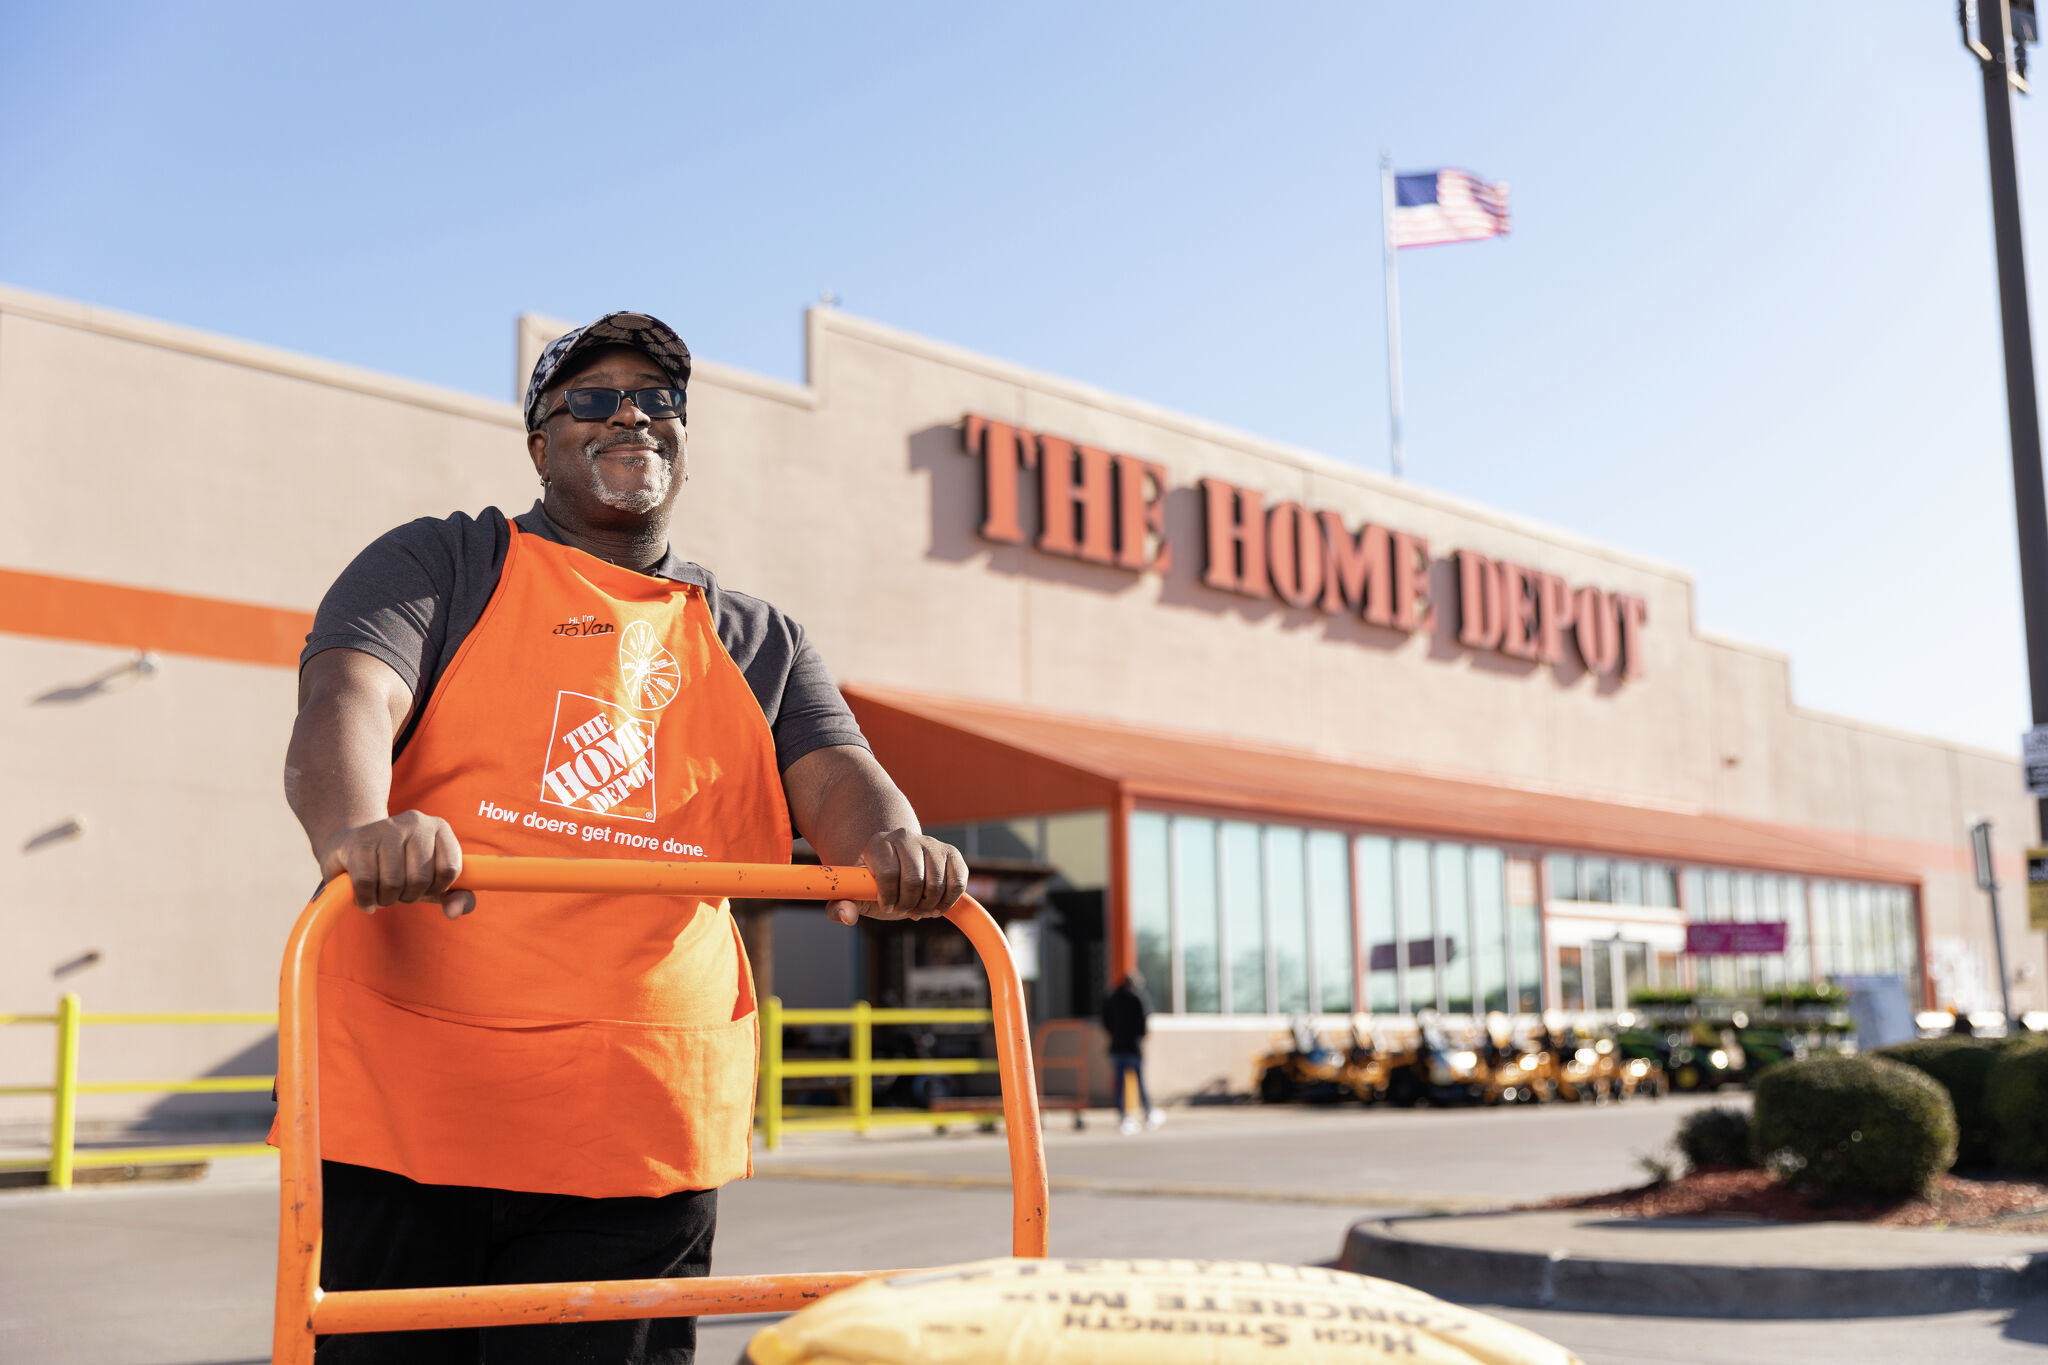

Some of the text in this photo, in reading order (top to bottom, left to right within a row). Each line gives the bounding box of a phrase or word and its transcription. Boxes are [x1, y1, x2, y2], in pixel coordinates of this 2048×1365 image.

[962, 414, 1647, 679] THE HOME DEPOT
[544, 718, 654, 806] HOME
[562, 712, 615, 754] THE
[586, 757, 654, 813] DEPOT
[478, 800, 709, 858] How doers get more done.
